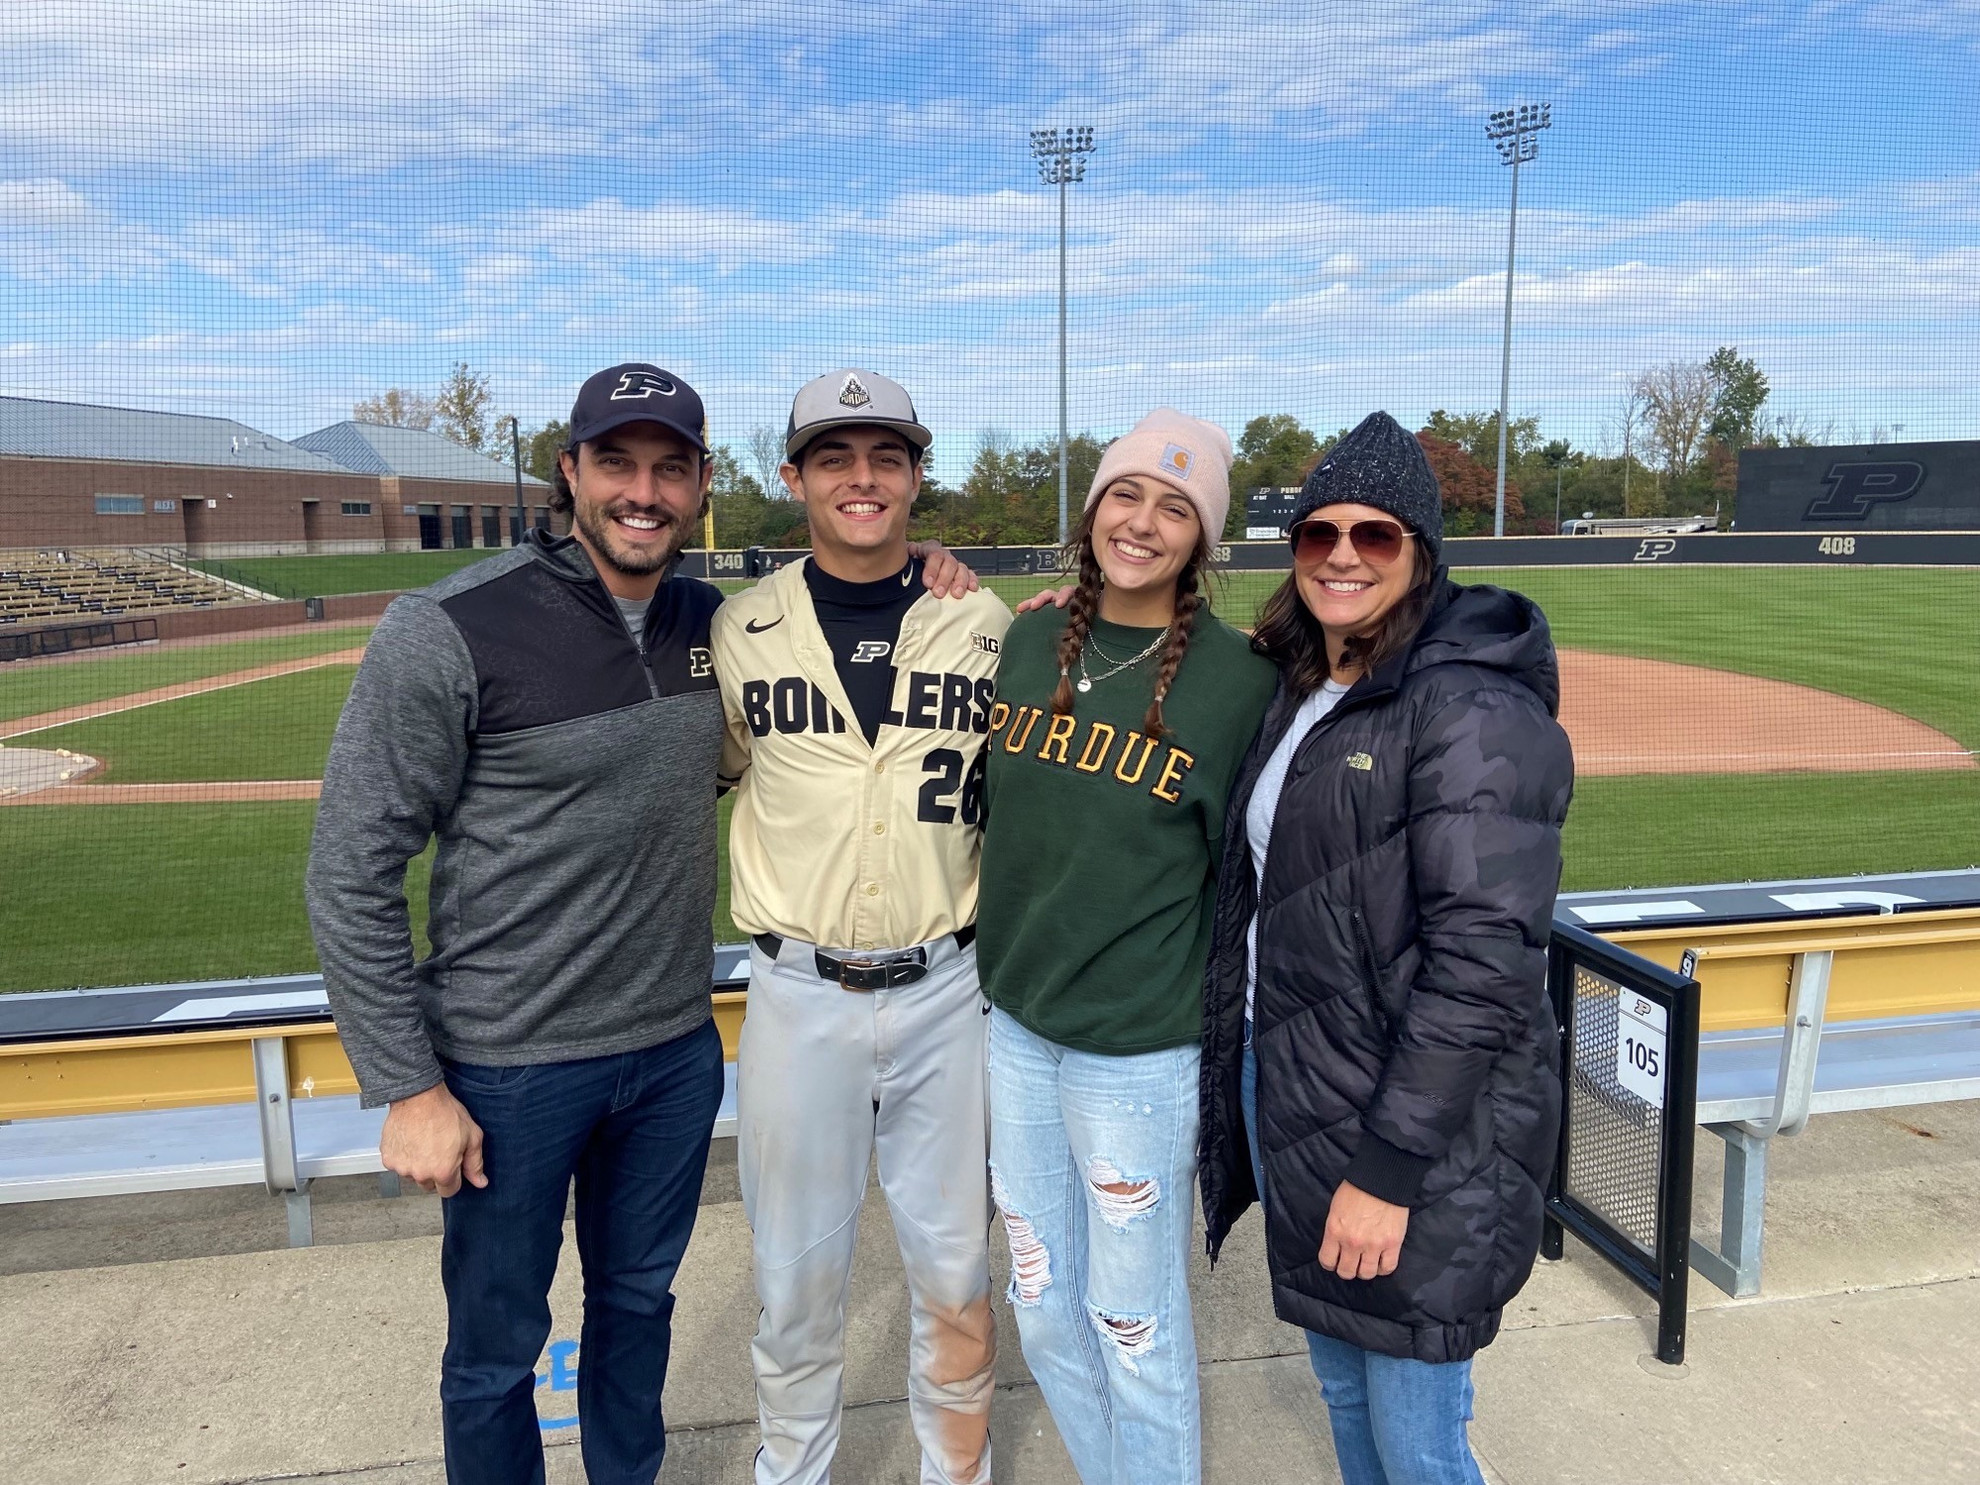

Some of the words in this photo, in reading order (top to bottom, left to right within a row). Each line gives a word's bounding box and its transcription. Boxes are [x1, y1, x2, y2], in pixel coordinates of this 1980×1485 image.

[610, 371, 677, 400] P
[841, 393, 869, 405] PURDUE
[1802, 460, 1928, 521] P
[1633, 539, 1676, 561] P
[1818, 536, 1855, 555] 408
[714, 553, 744, 570] 340
[690, 647, 712, 677] P
[850, 641, 891, 663] P
[987, 702, 1195, 805] PURDUE
[917, 747, 986, 825] 26
[1634, 998, 1652, 1017] P
[1625, 1037, 1660, 1078] 105
